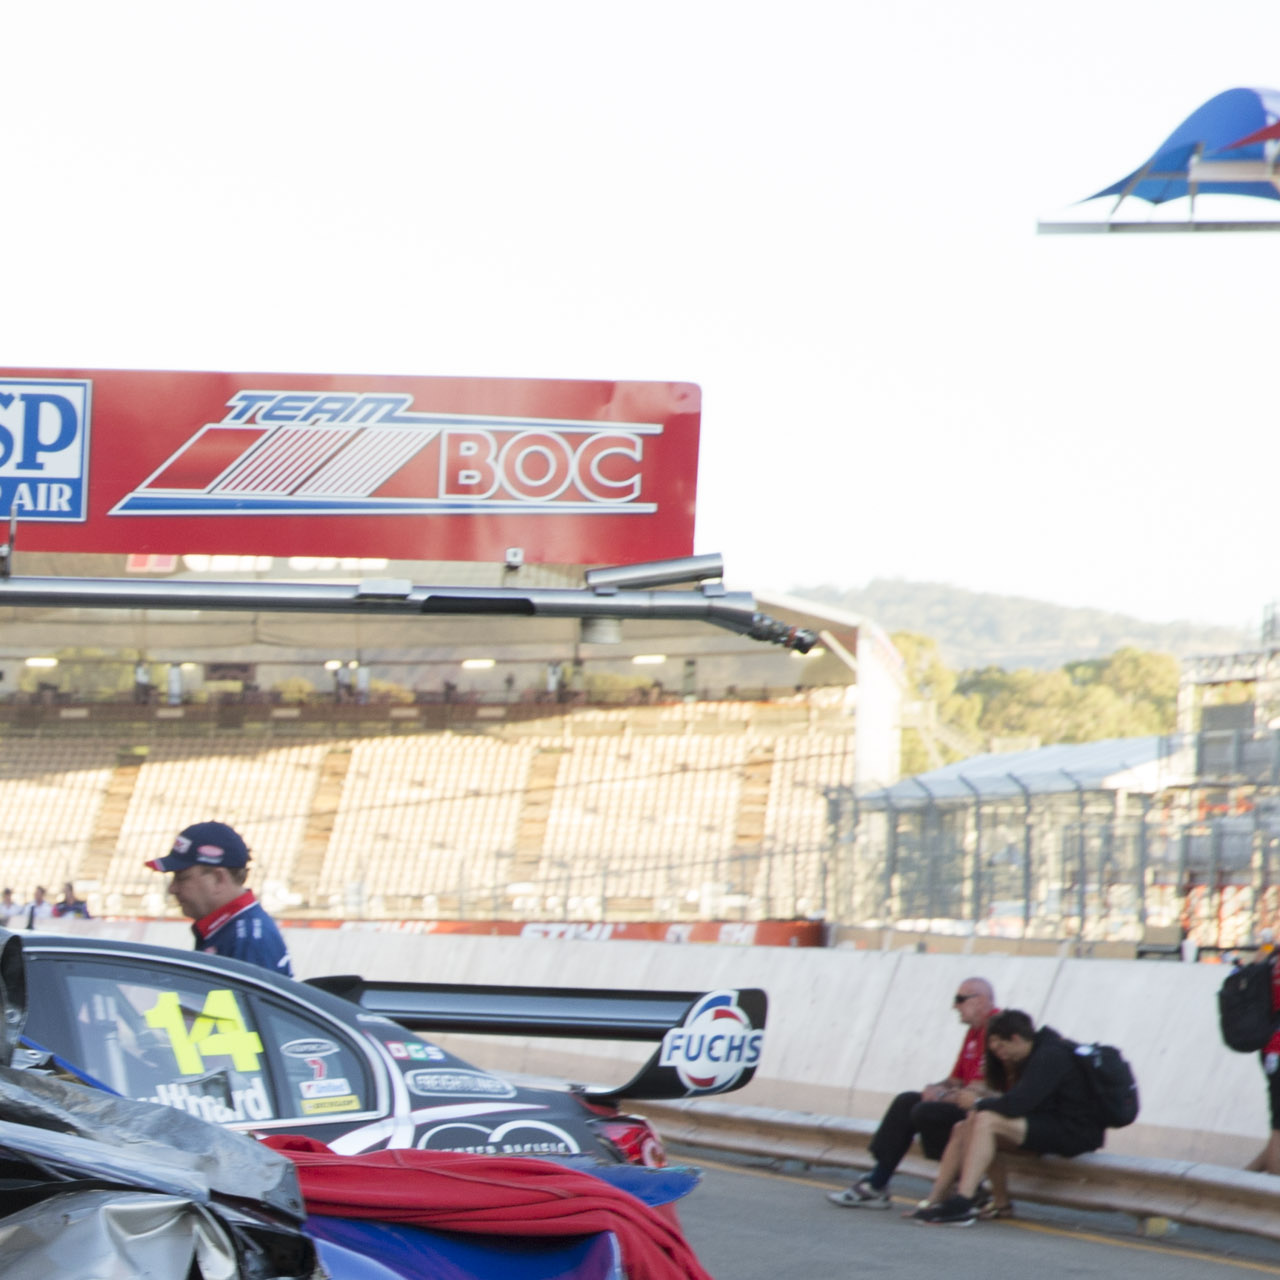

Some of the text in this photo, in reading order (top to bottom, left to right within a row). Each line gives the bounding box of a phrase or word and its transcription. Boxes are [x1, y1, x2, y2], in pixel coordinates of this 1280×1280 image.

[220, 391, 414, 425] TEAM
[439, 429, 643, 503] BOC
[11, 483, 72, 512] AIR
[143, 989, 264, 1075] 14
[666, 1033, 763, 1063] FUCHS
